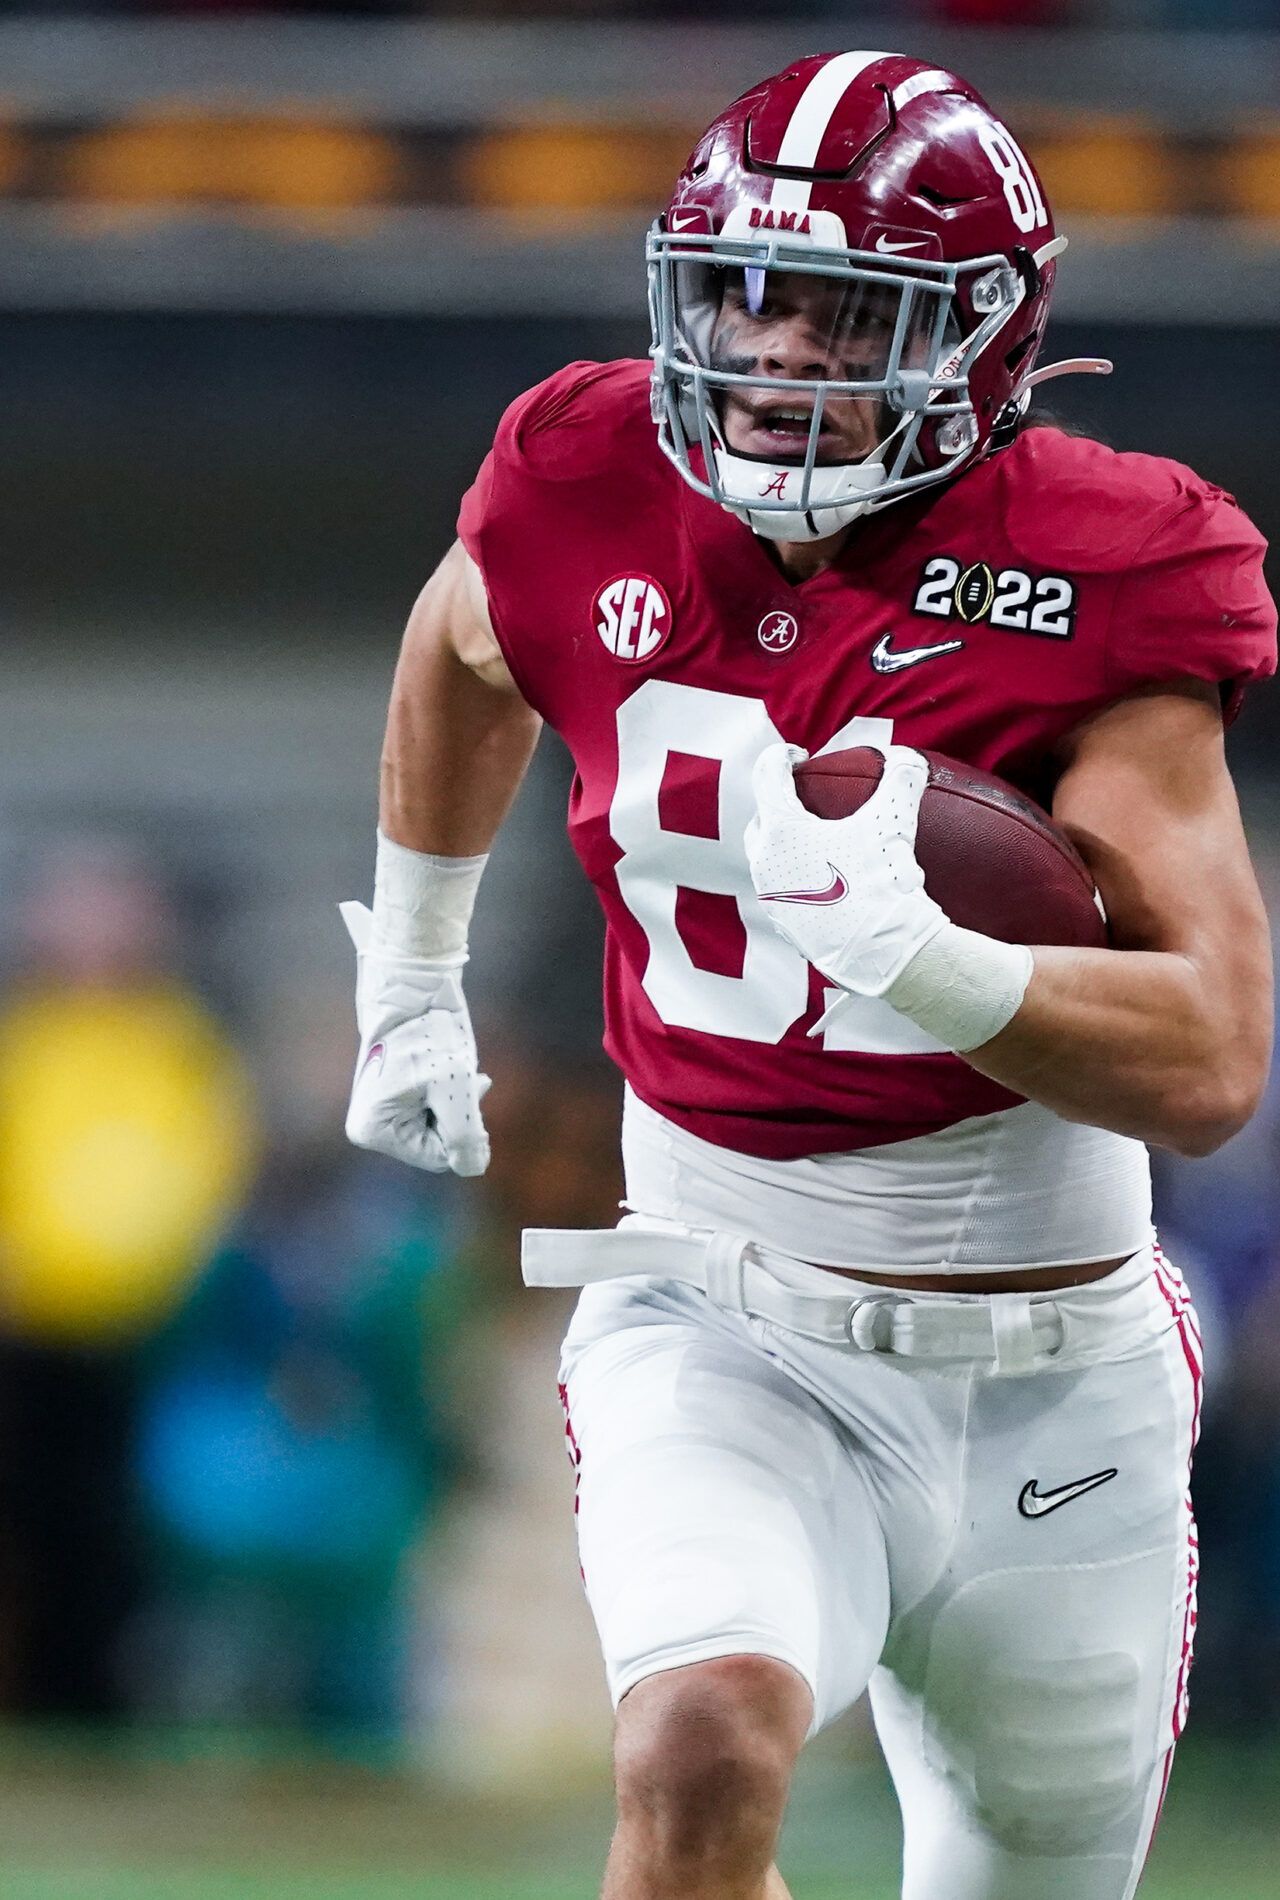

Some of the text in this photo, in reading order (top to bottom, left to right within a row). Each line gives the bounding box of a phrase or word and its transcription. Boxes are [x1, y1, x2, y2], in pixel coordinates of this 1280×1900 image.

[978, 120, 1049, 234] 81
[748, 207, 811, 235] BAMA
[597, 578, 666, 659] SEC
[914, 557, 1074, 636] 2022
